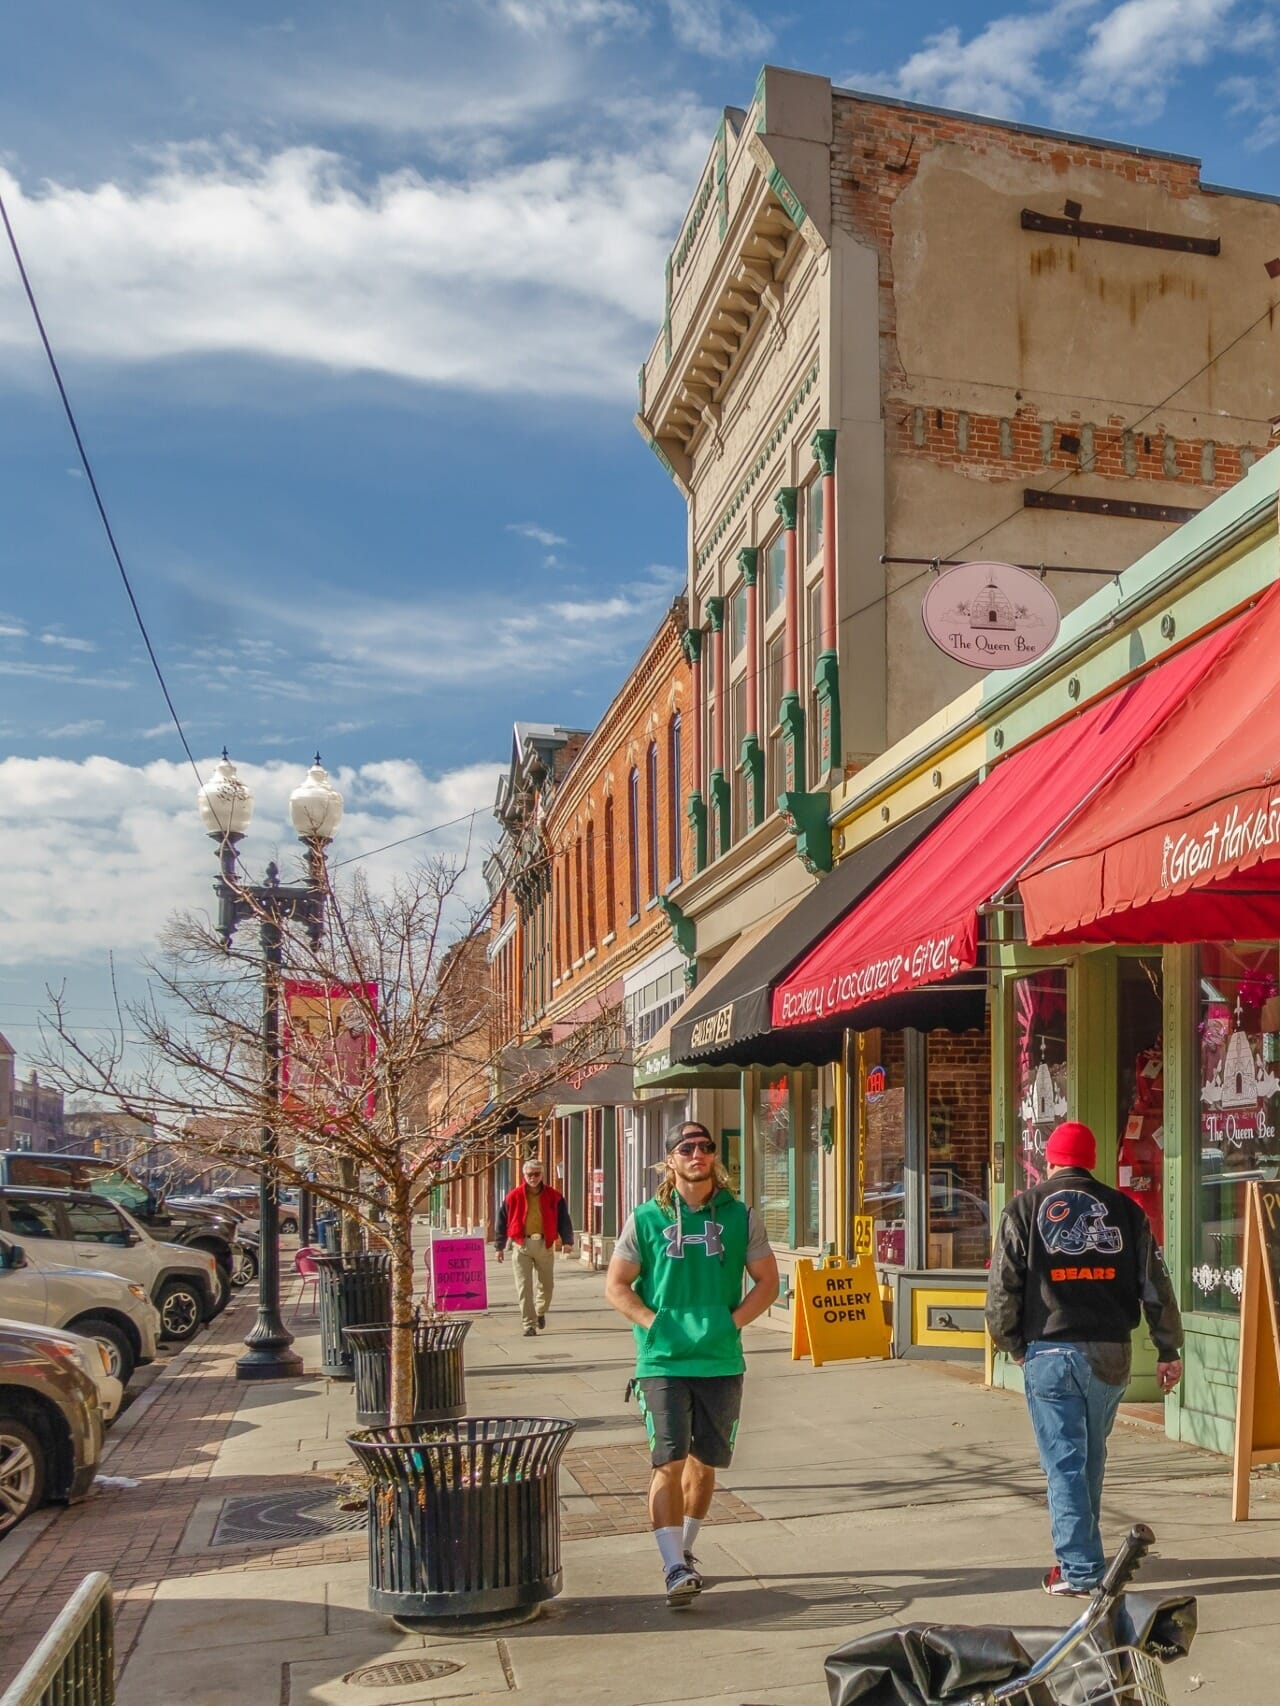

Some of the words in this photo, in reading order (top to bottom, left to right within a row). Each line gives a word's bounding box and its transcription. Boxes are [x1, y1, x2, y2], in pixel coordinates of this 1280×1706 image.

[949, 633, 971, 649] The
[975, 635, 1010, 655] Queen
[1014, 635, 1036, 652] Bee
[1170, 821, 1219, 883] Great
[691, 1014, 719, 1048] GALLERY
[718, 1010, 730, 1039] 25
[866, 1071, 886, 1096] OPEN
[1206, 1115, 1223, 1142] The
[1226, 1114, 1254, 1149] Queen
[1257, 1108, 1276, 1139] Bee
[856, 1219, 872, 1247] 25
[437, 1271, 482, 1284] BOUTIQUE
[826, 1278, 853, 1292] ART
[1050, 1267, 1116, 1282] BEARS
[812, 1292, 871, 1308] GALLERY
[824, 1308, 866, 1323] OPEN
